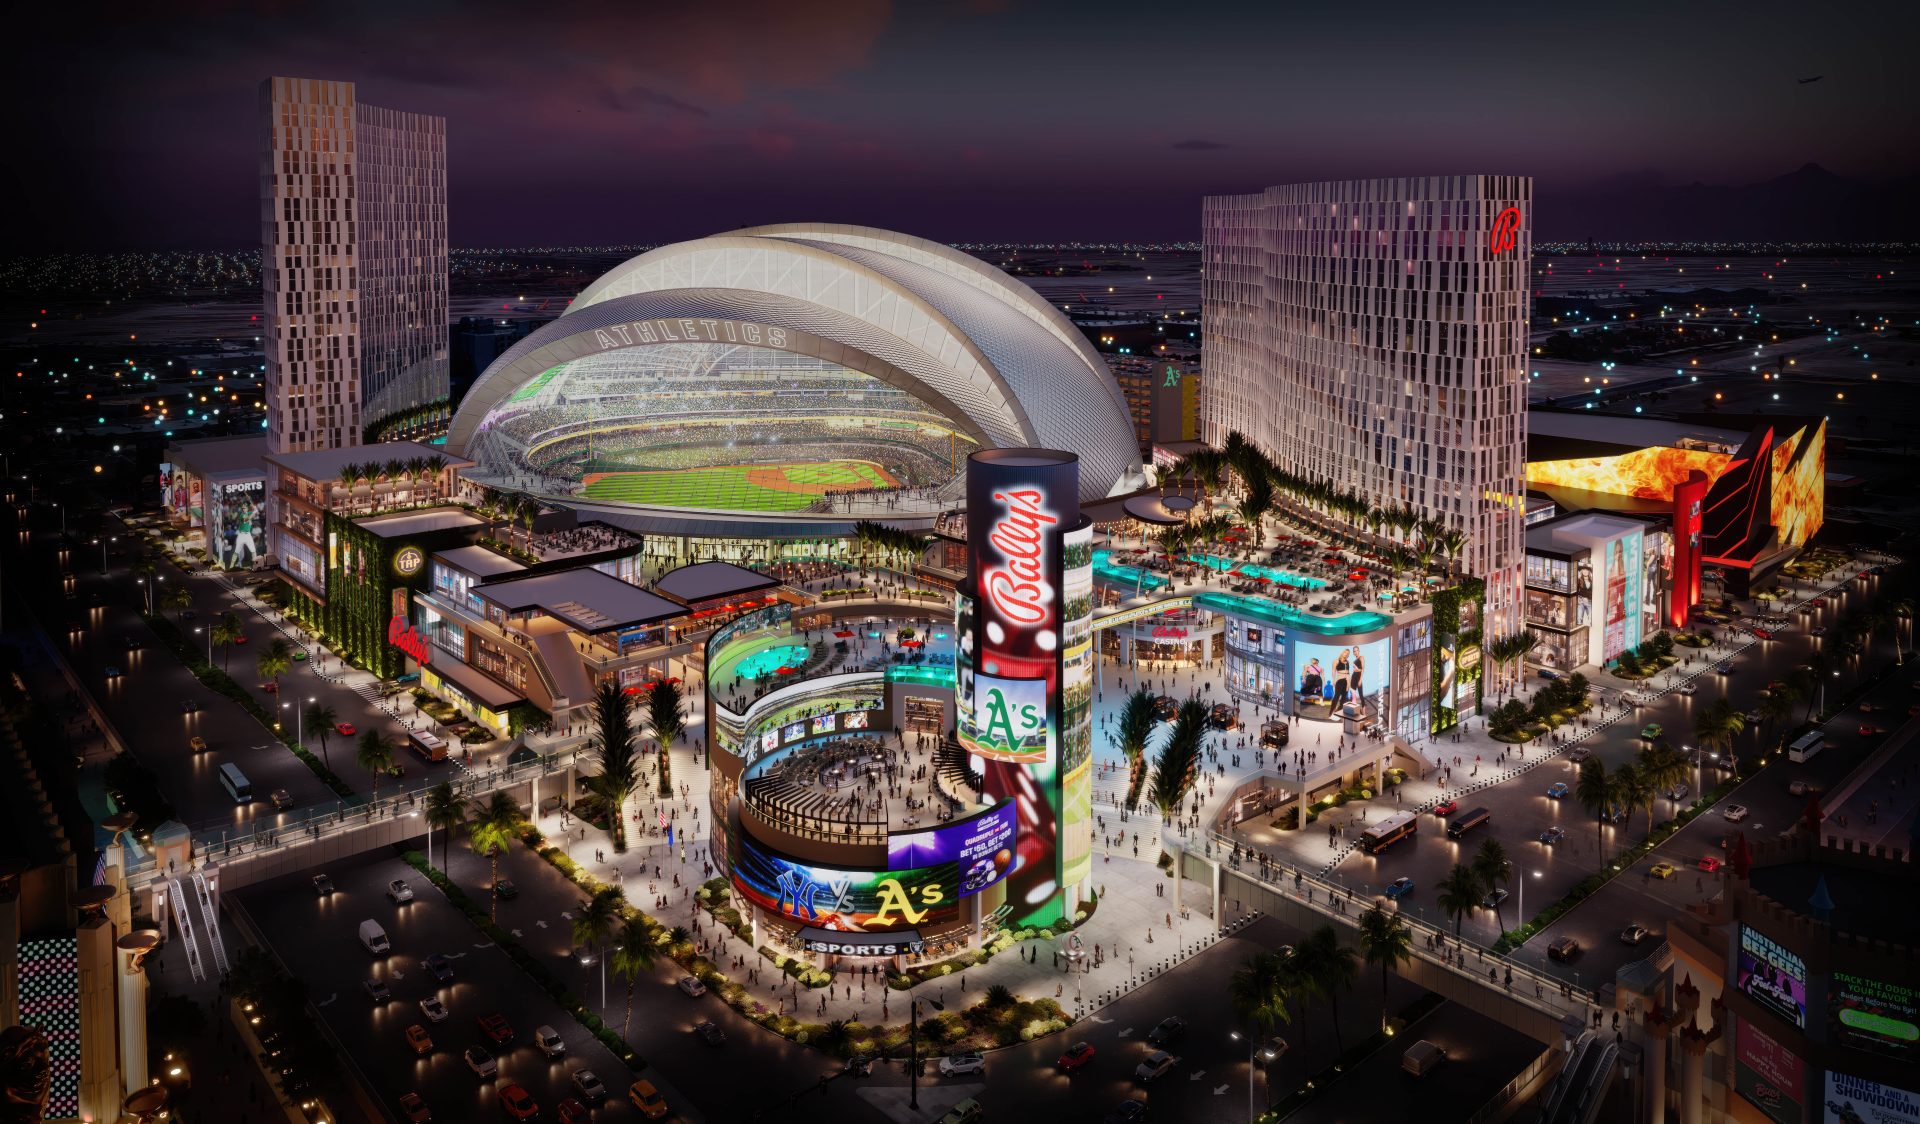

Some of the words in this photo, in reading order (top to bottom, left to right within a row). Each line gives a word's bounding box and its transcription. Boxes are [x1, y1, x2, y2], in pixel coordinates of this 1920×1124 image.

[595, 319, 787, 349] ATHLETICS
[226, 481, 263, 494] SPORTS
[399, 557, 420, 569] TAP
[990, 489, 1057, 624] Bally's
[388, 615, 429, 668] Bally's
[1151, 626, 1189, 640] Bally's
[960, 847, 973, 858] BET
[816, 942, 897, 956] SPORTS
[1745, 927, 1806, 971] AUSTRALIAN
[1833, 972, 1862, 986] STACK
[1865, 979, 1883, 990] THE
[1885, 984, 1913, 997] ODDS
[1848, 984, 1874, 997] YOUR
[1876, 991, 1911, 1005] FAVOR.
[1840, 992, 1864, 1003] Budget
[1865, 996, 1887, 1008] Before
[1889, 1002, 1901, 1011] You
[1832, 1072, 1881, 1095] DINNER
[1885, 1089, 1902, 1101] AND
[1904, 1094, 1910, 1102] A
[1835, 1084, 1919, 1117] SHOWDOWN
